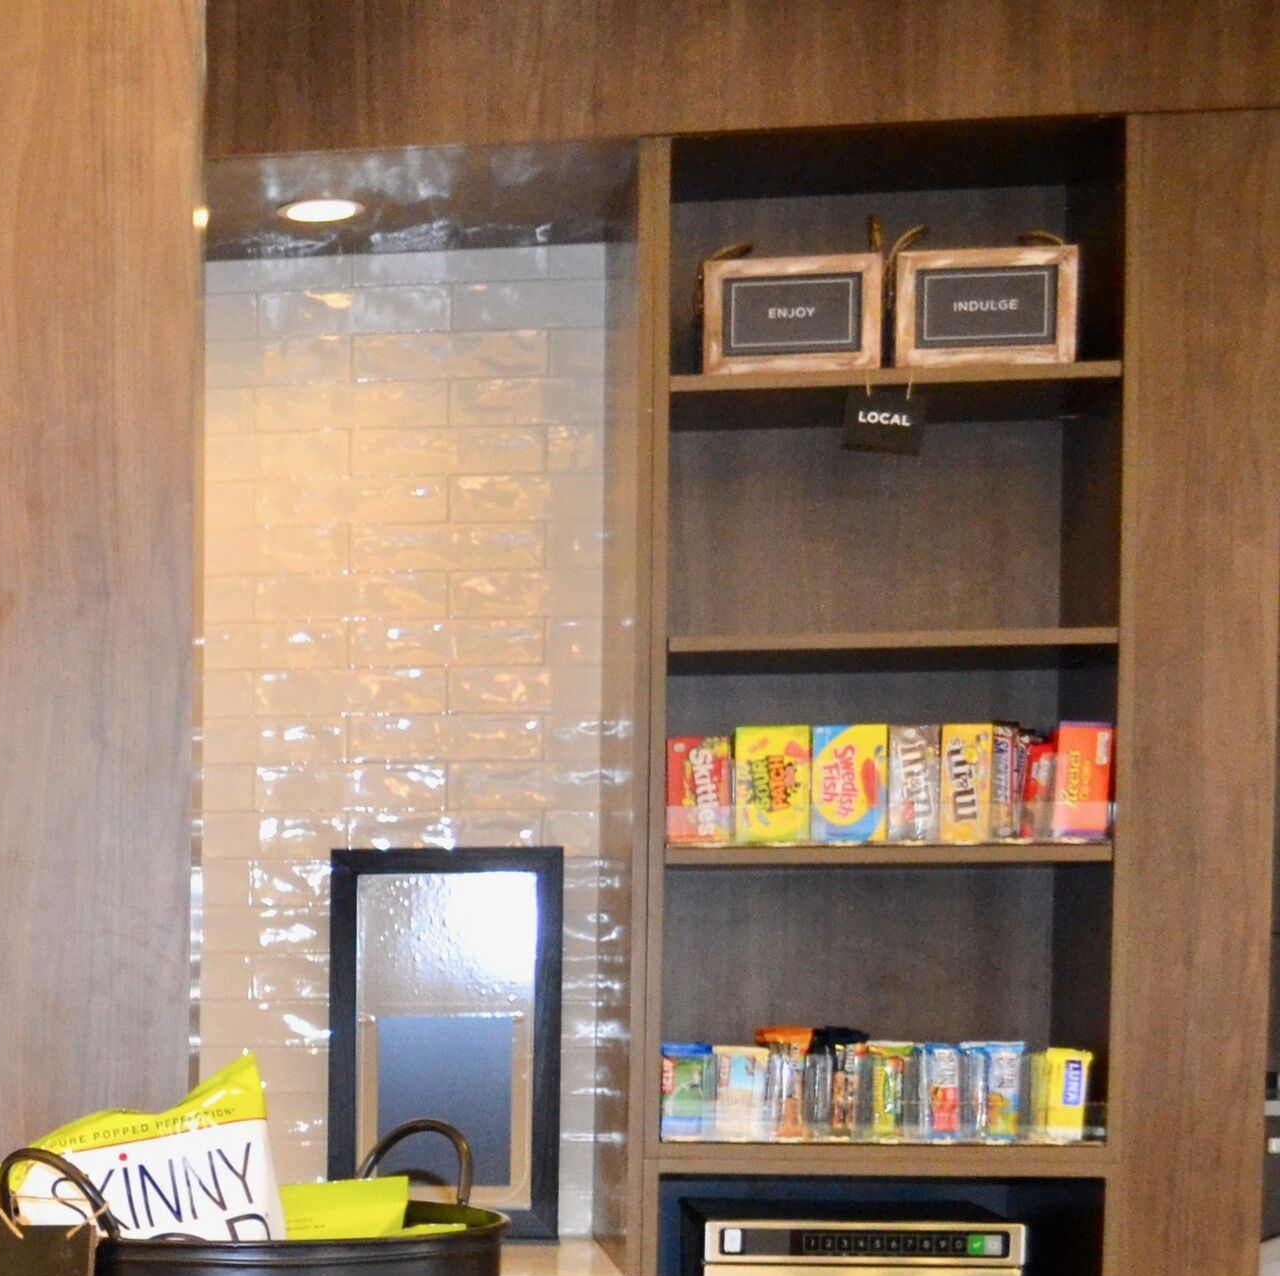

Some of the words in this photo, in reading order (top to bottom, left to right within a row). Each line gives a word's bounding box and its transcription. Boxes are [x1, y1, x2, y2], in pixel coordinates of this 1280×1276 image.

[768, 306, 816, 320] ENJOY
[953, 298, 1019, 313] INDULGE
[858, 410, 911, 428] LOCAL
[823, 764, 840, 803] Fish
[833, 744, 857, 817] Swedish
[689, 748, 719, 836] Skittles
[93, 1123, 150, 1141] POPPED
